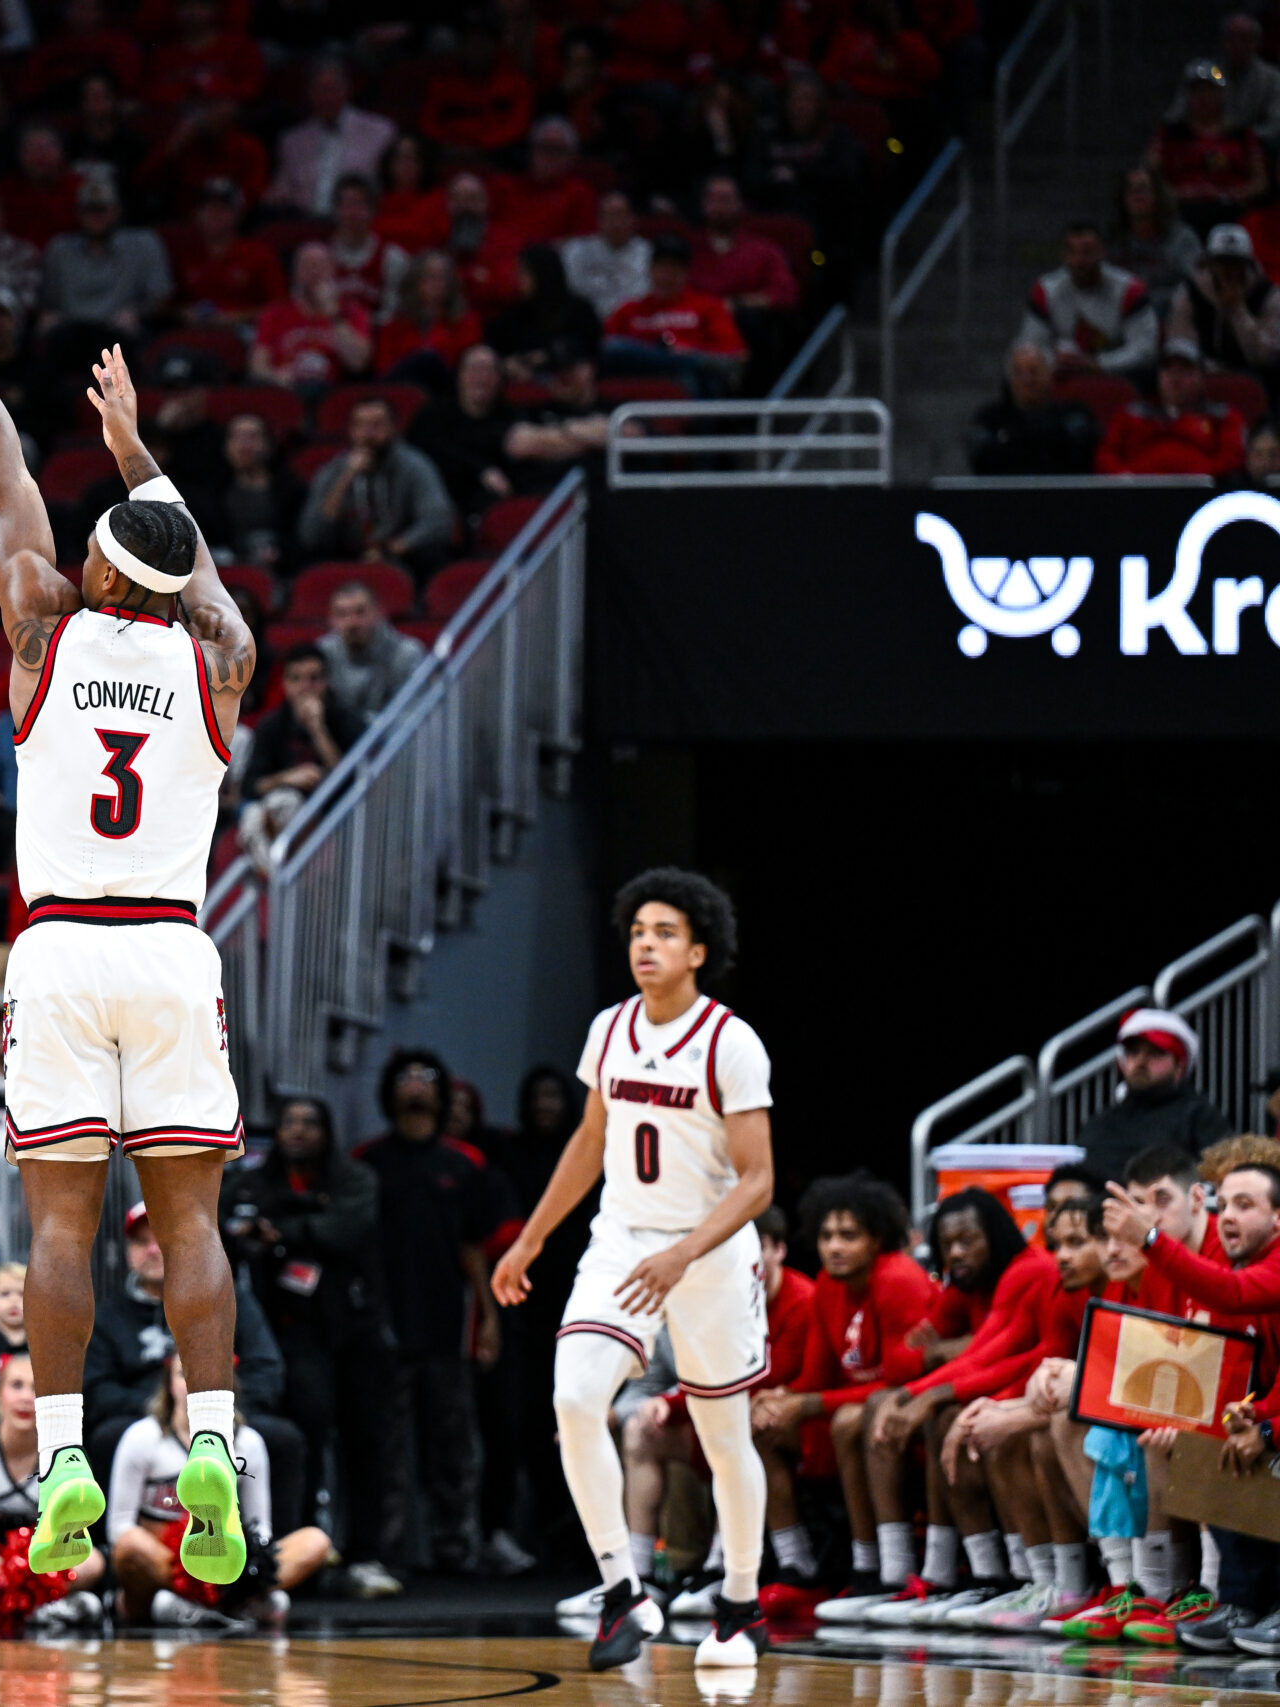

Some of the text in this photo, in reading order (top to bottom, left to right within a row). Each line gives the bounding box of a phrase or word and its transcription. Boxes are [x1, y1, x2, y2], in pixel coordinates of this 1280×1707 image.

[1119, 490, 1280, 656] Kr
[73, 681, 175, 721] CONWELL
[90, 727, 151, 840] 3
[635, 1122, 660, 1184] 0
